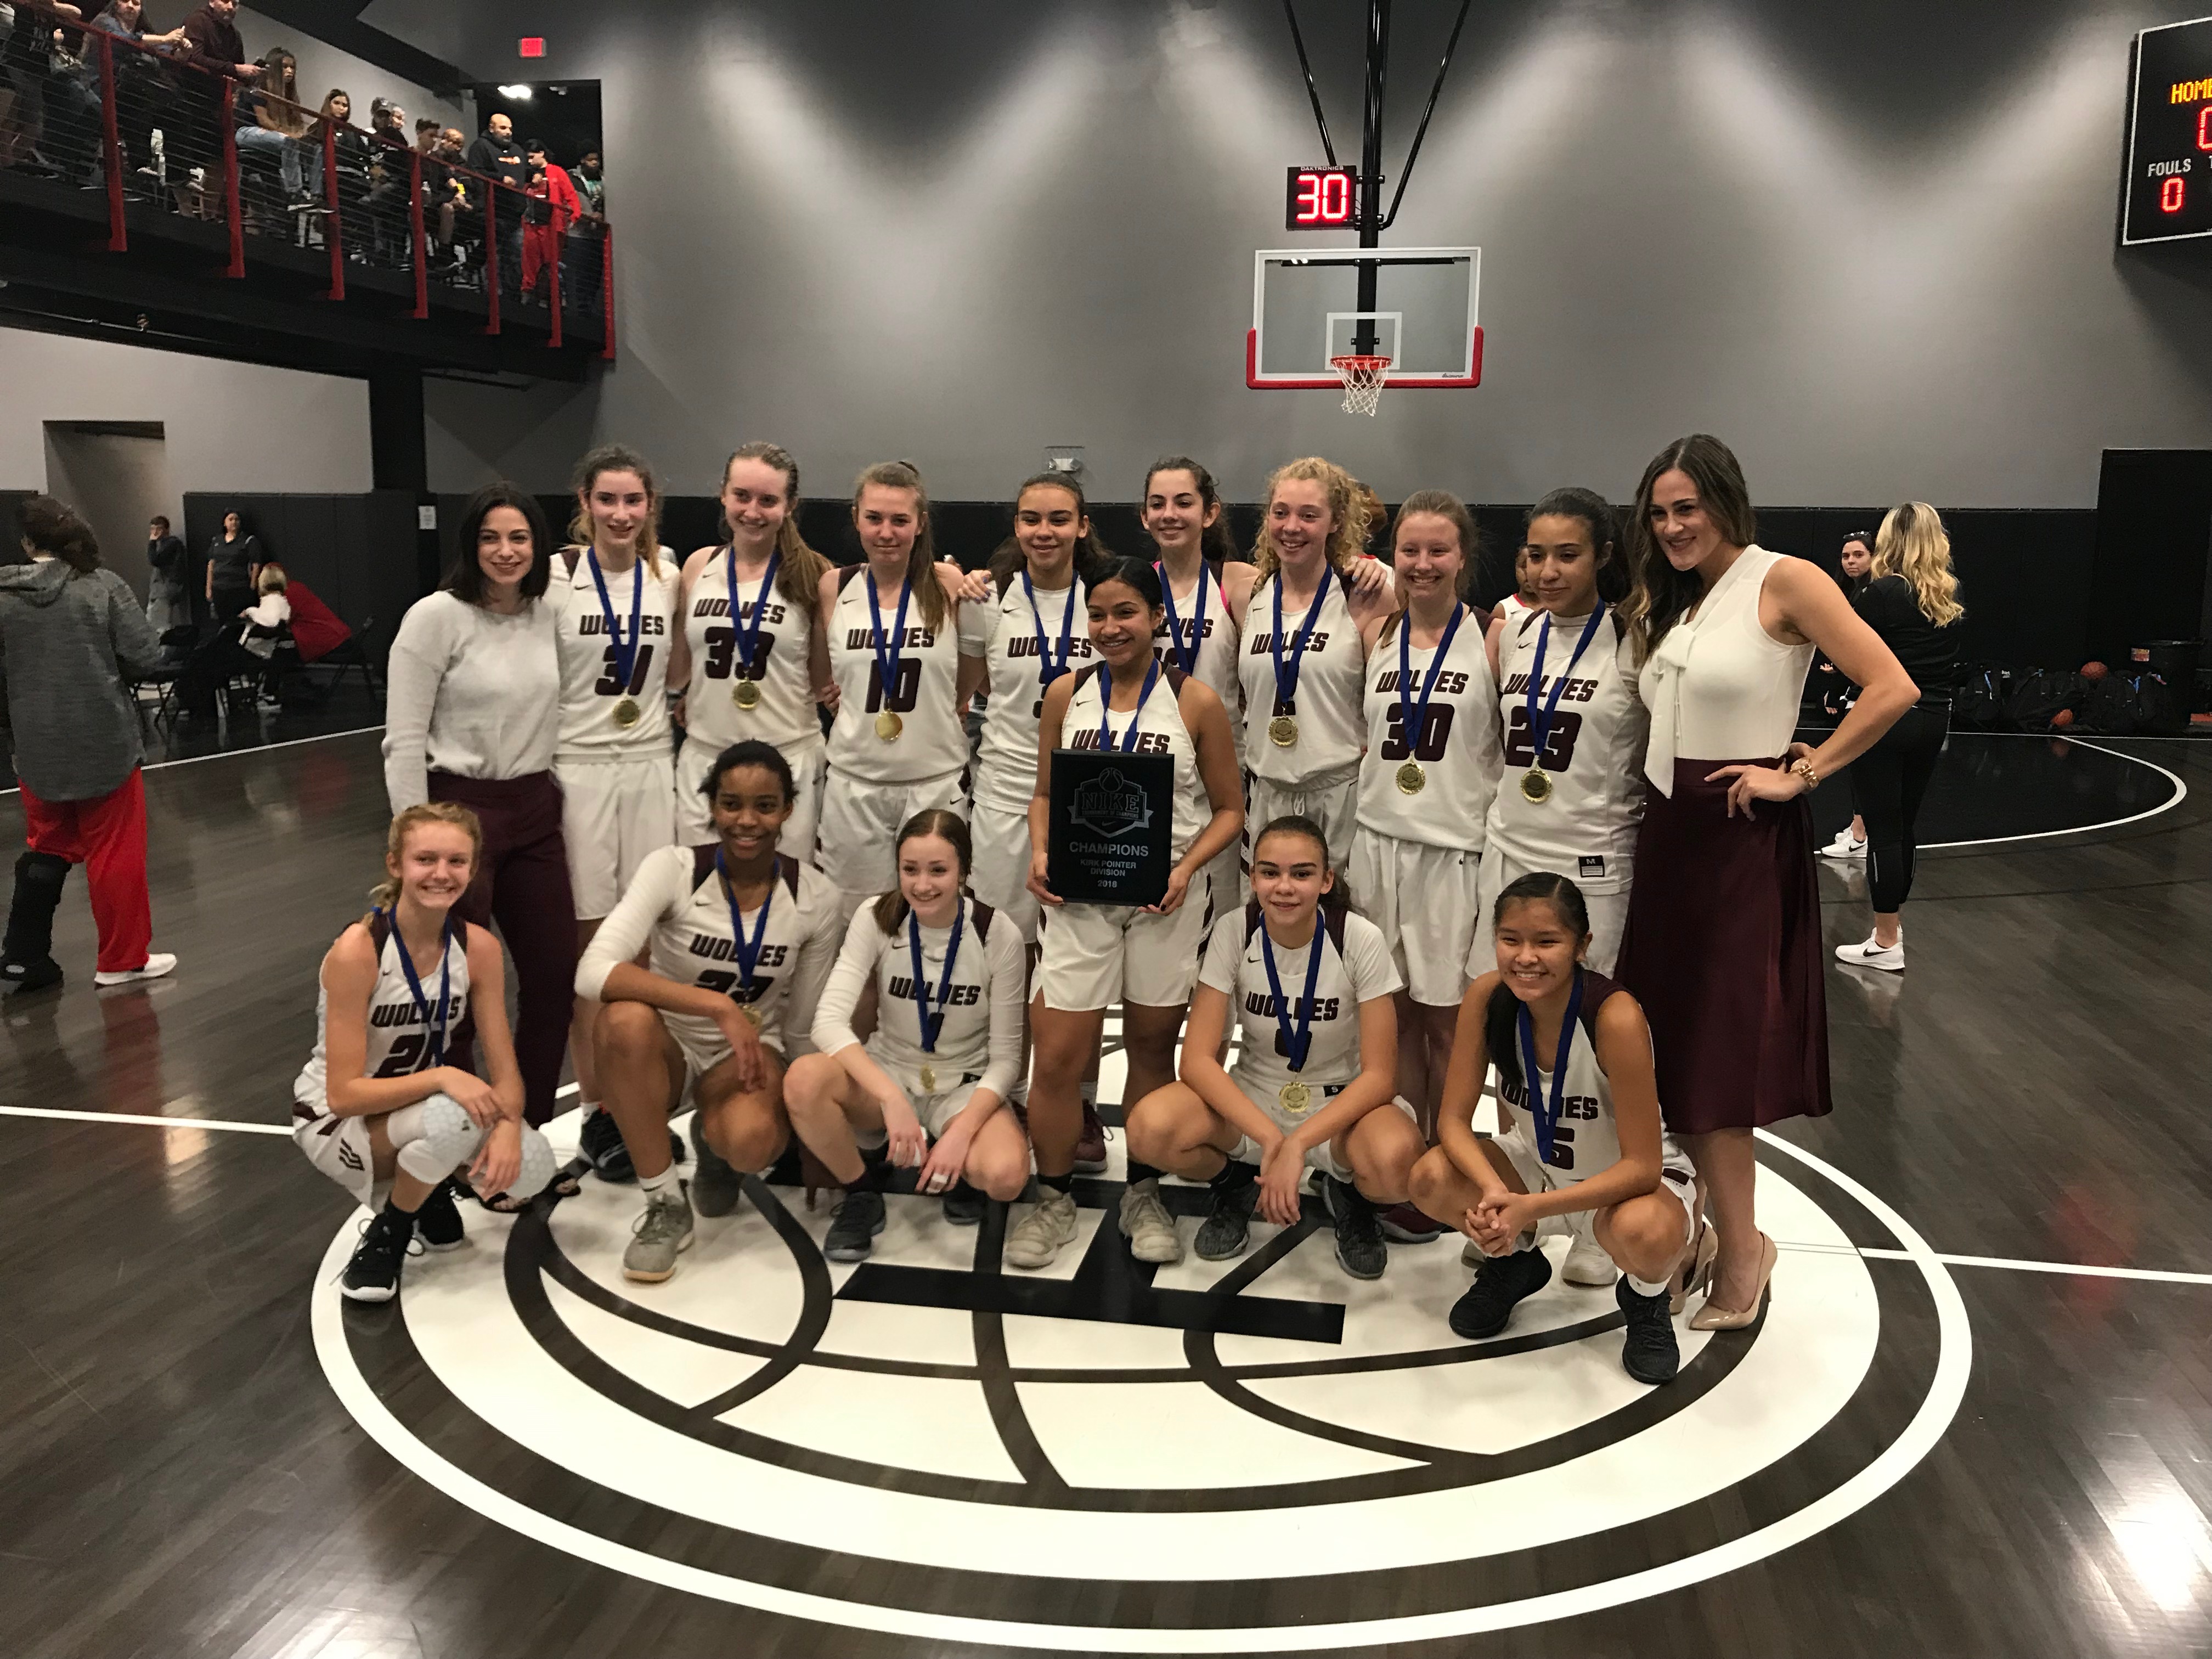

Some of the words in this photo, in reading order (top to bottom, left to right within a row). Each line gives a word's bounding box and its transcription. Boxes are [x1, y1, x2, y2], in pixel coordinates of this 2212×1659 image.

[2147, 158, 2191, 177] FOULS
[1297, 173, 1348, 221] 30
[2161, 177, 2185, 213] 0
[864, 658, 922, 714] 10
[1375, 669, 1469, 695] WOLES
[1381, 702, 1455, 762] 30
[1505, 706, 1582, 772] 23
[1081, 792, 1139, 813] NIKE
[1069, 841, 1149, 857] CHAMPIONS
[1090, 867, 1126, 877] DIVISION
[1101, 860, 1136, 869] POINTER
[1097, 879, 1117, 888] 2018
[689, 933, 788, 967] WOLES
[1500, 1079, 1599, 1121] WOES
